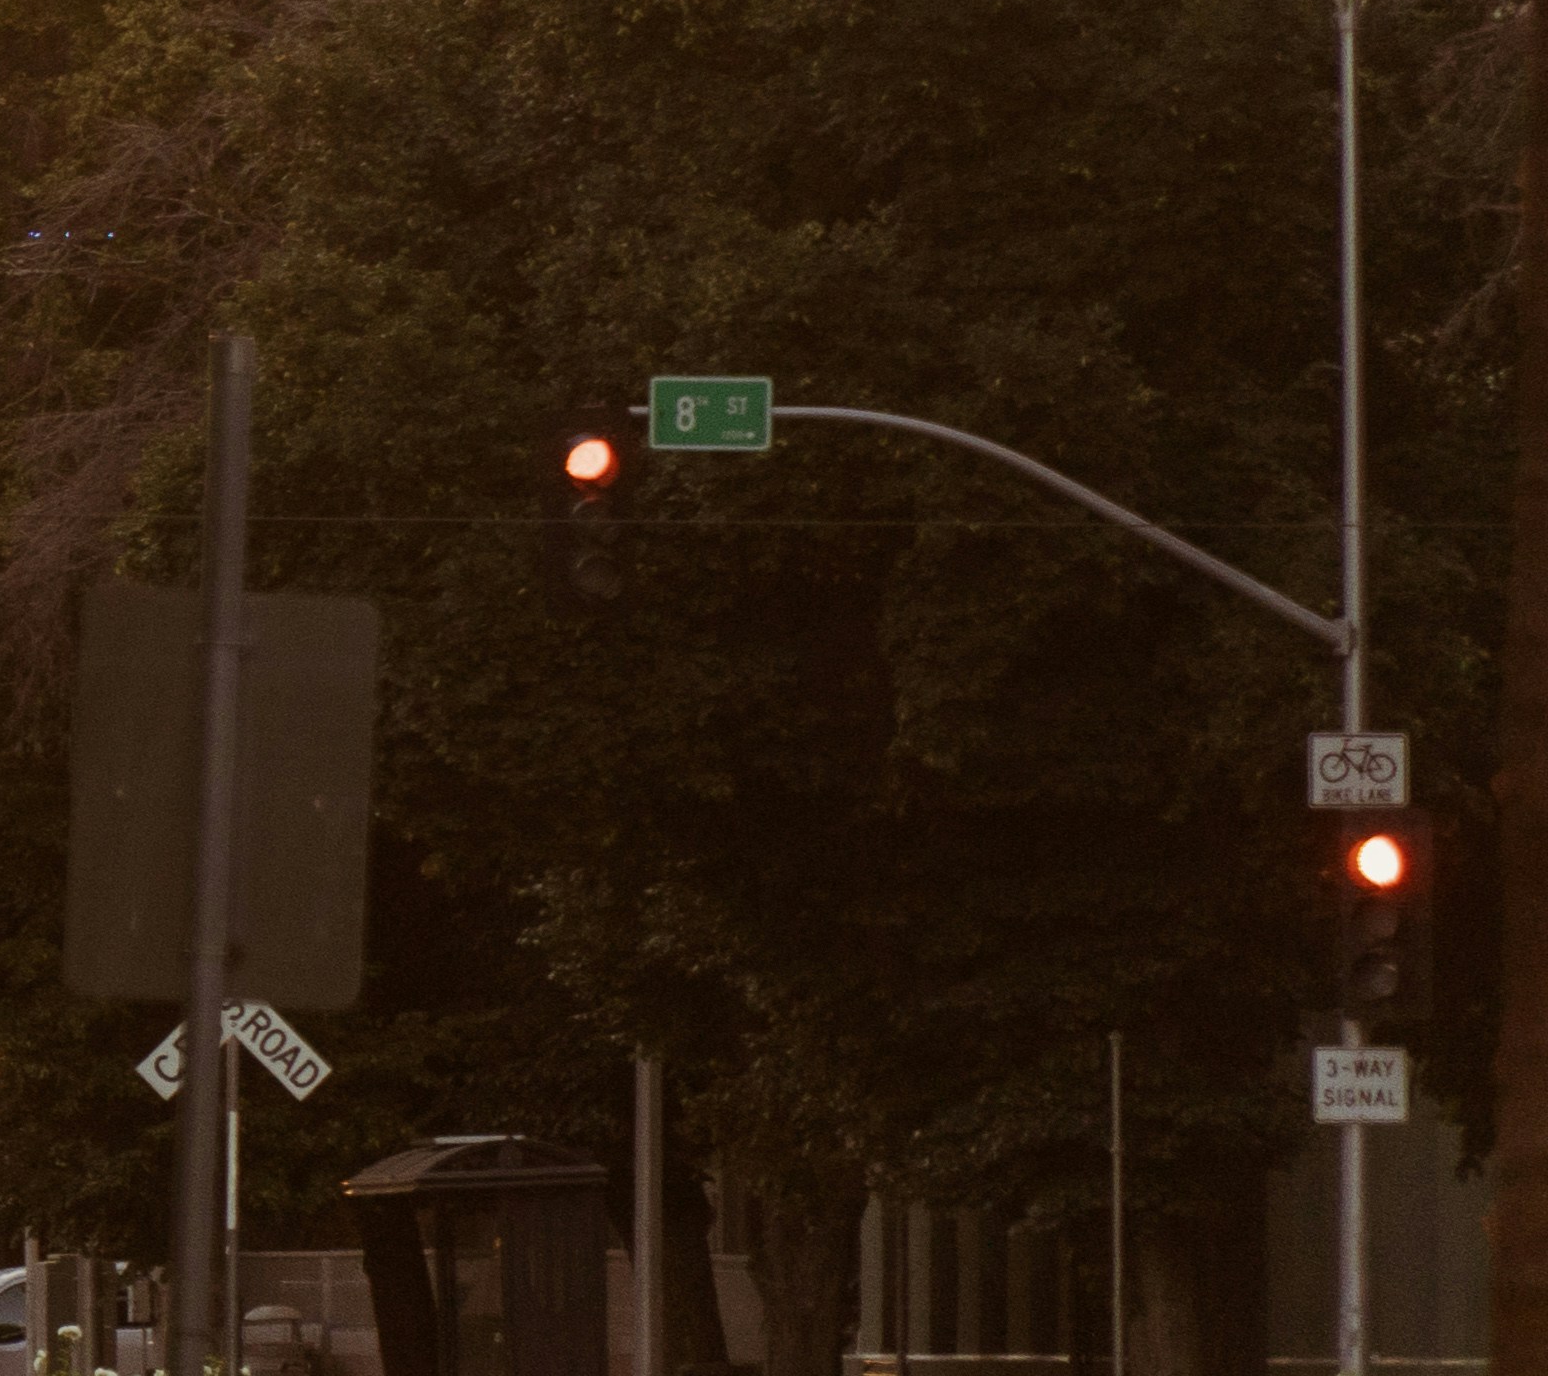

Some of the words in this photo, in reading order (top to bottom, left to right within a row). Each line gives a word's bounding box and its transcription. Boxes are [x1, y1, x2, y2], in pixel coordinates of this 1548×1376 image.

[726, 396, 748, 416] ST
[240, 1009, 319, 1088] ROAD
[1325, 1058, 1394, 1078] 3-WAY
[1323, 1088, 1398, 1107] SIGNAL
